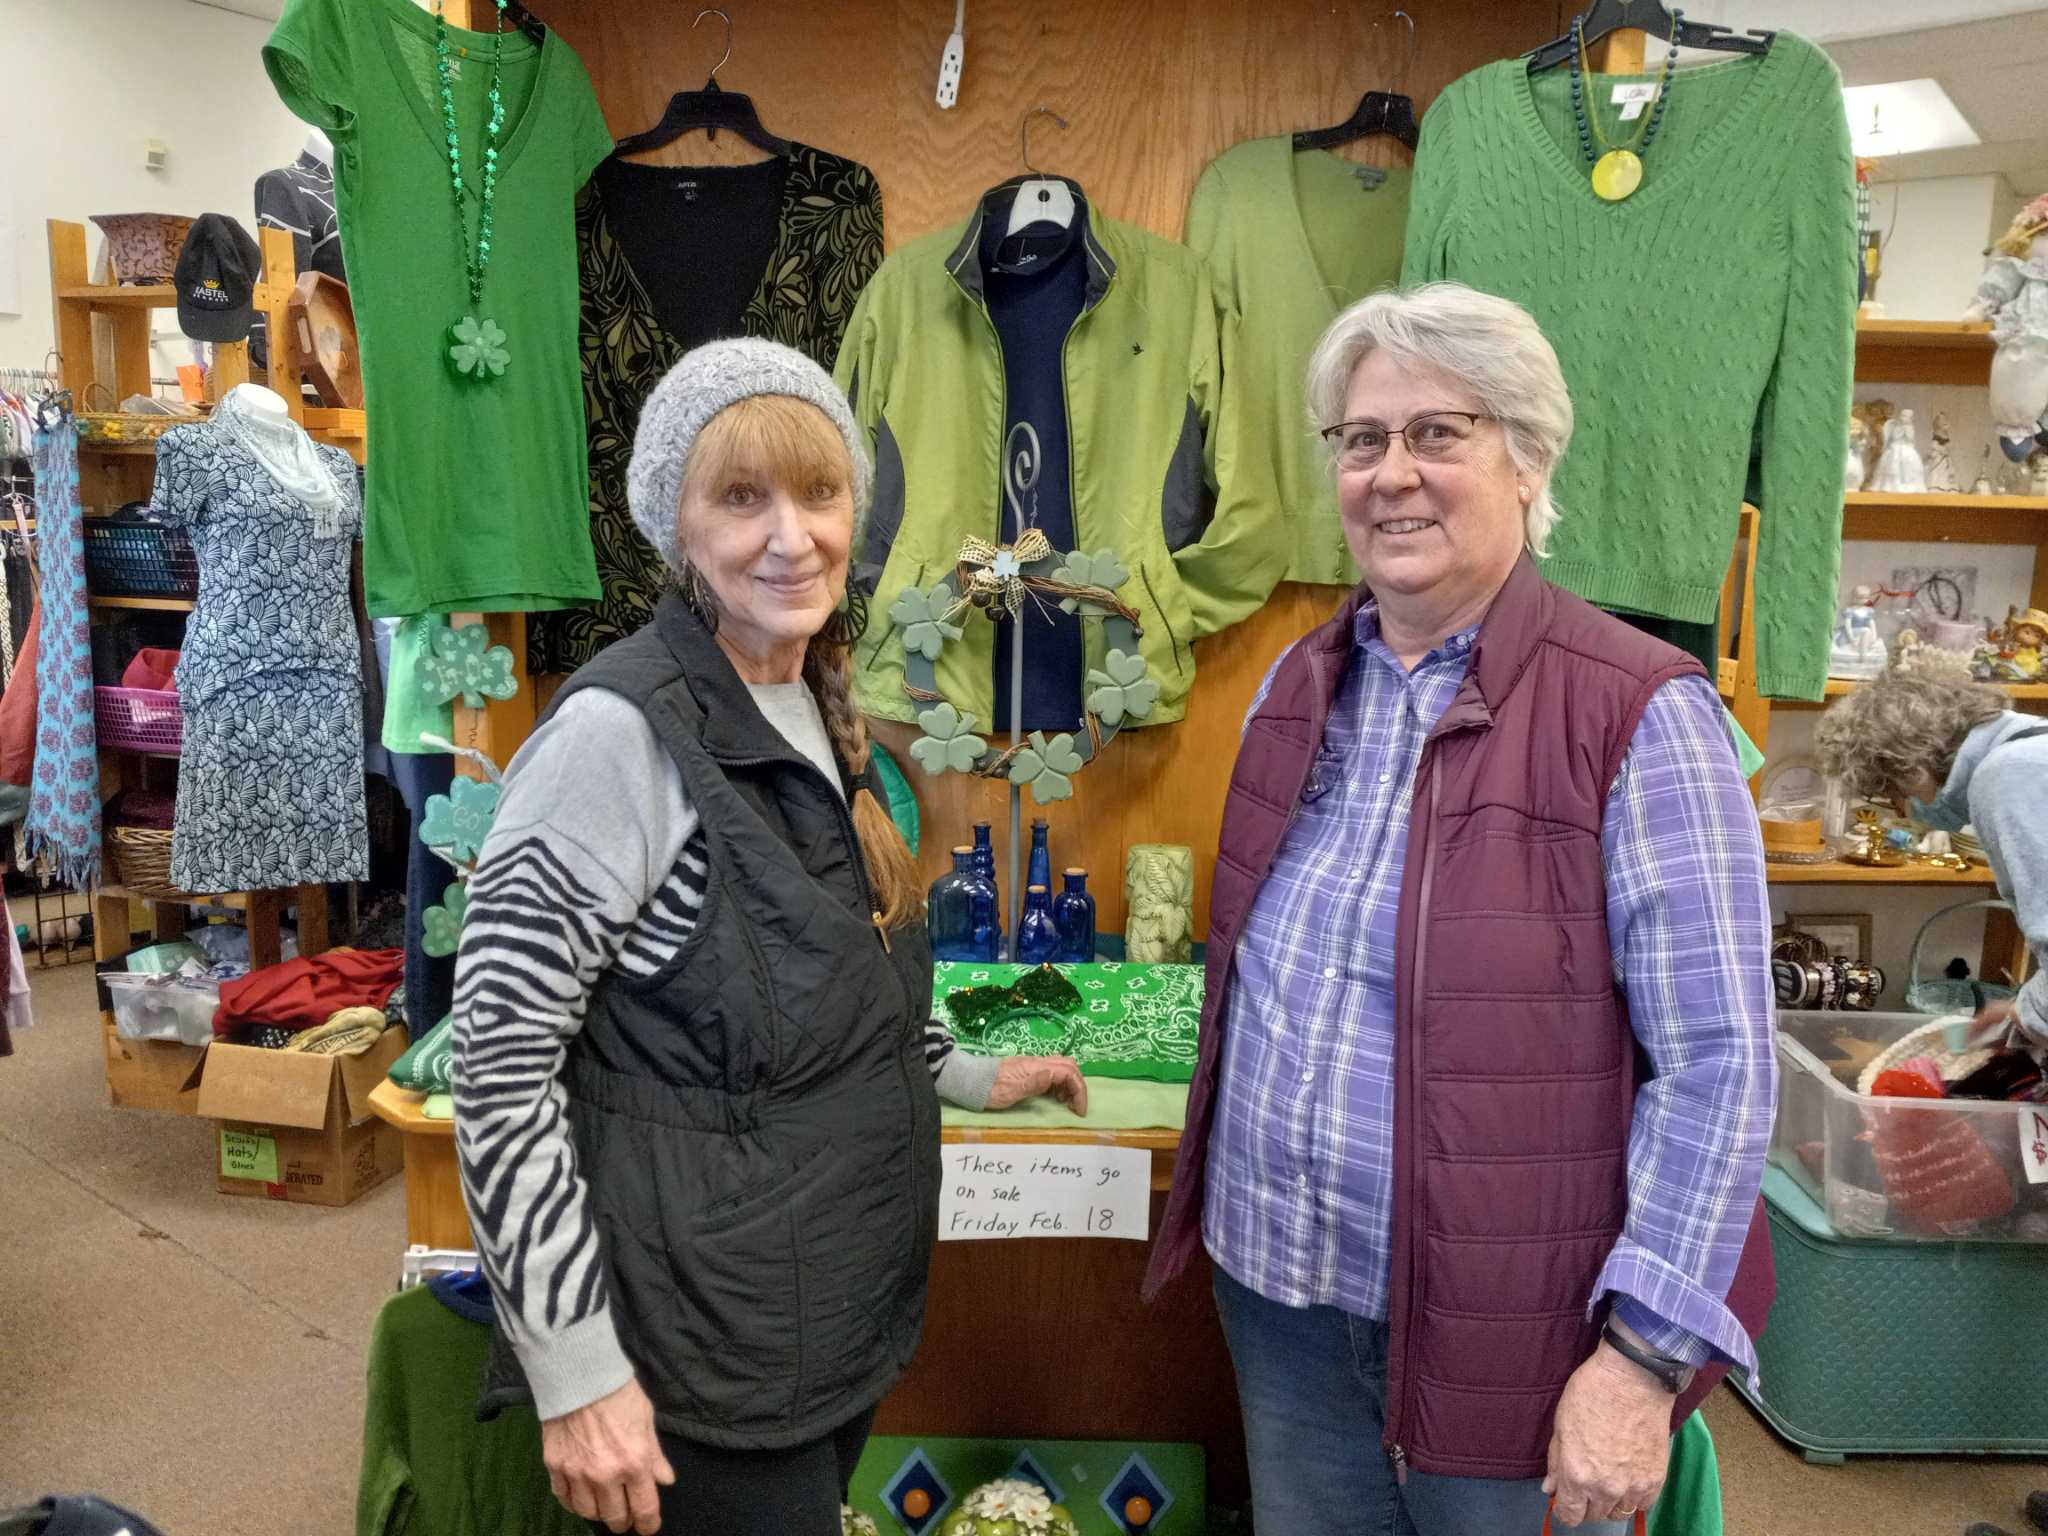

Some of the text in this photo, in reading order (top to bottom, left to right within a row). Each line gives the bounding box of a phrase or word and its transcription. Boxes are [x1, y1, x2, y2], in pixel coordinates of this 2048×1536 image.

[955, 1154, 1121, 1186] These items go
[955, 1185, 1021, 1202] on sale
[950, 1205, 1115, 1236] Friday Feb. 18
